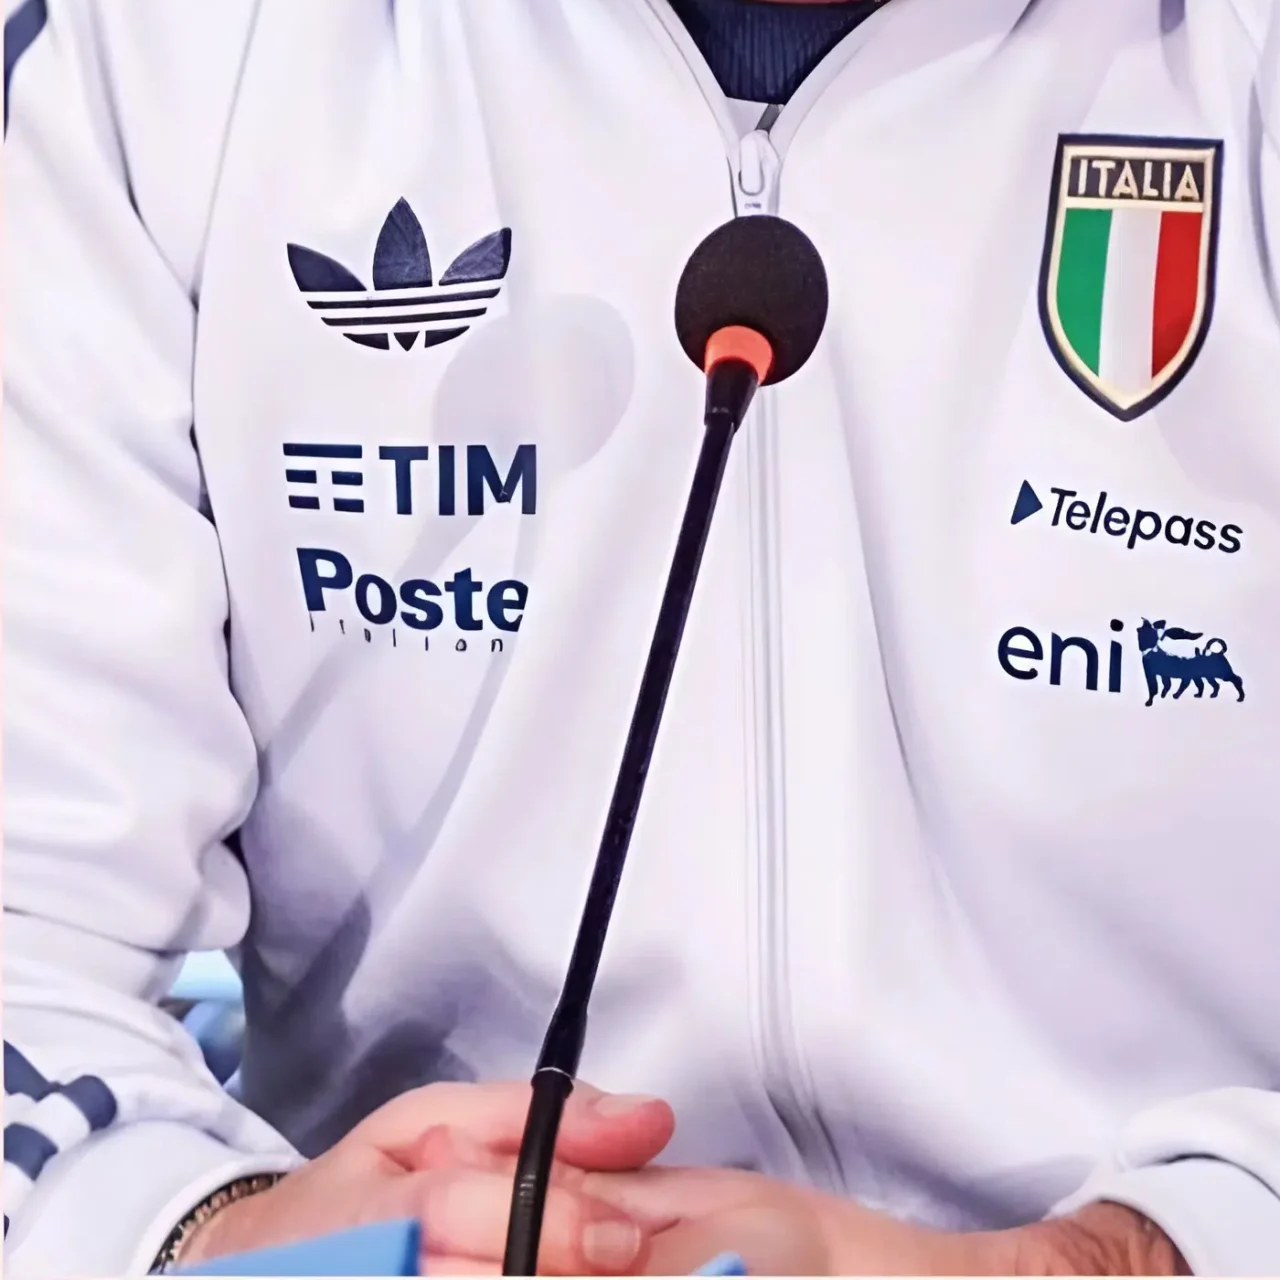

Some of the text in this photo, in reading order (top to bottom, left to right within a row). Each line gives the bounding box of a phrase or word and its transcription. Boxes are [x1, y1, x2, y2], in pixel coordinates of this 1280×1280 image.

[1075, 159, 1201, 201] ITALIA
[378, 443, 537, 516] TIM
[1049, 487, 1244, 554] Telepass
[296, 546, 529, 632] Poste
[997, 618, 1123, 694] eni
